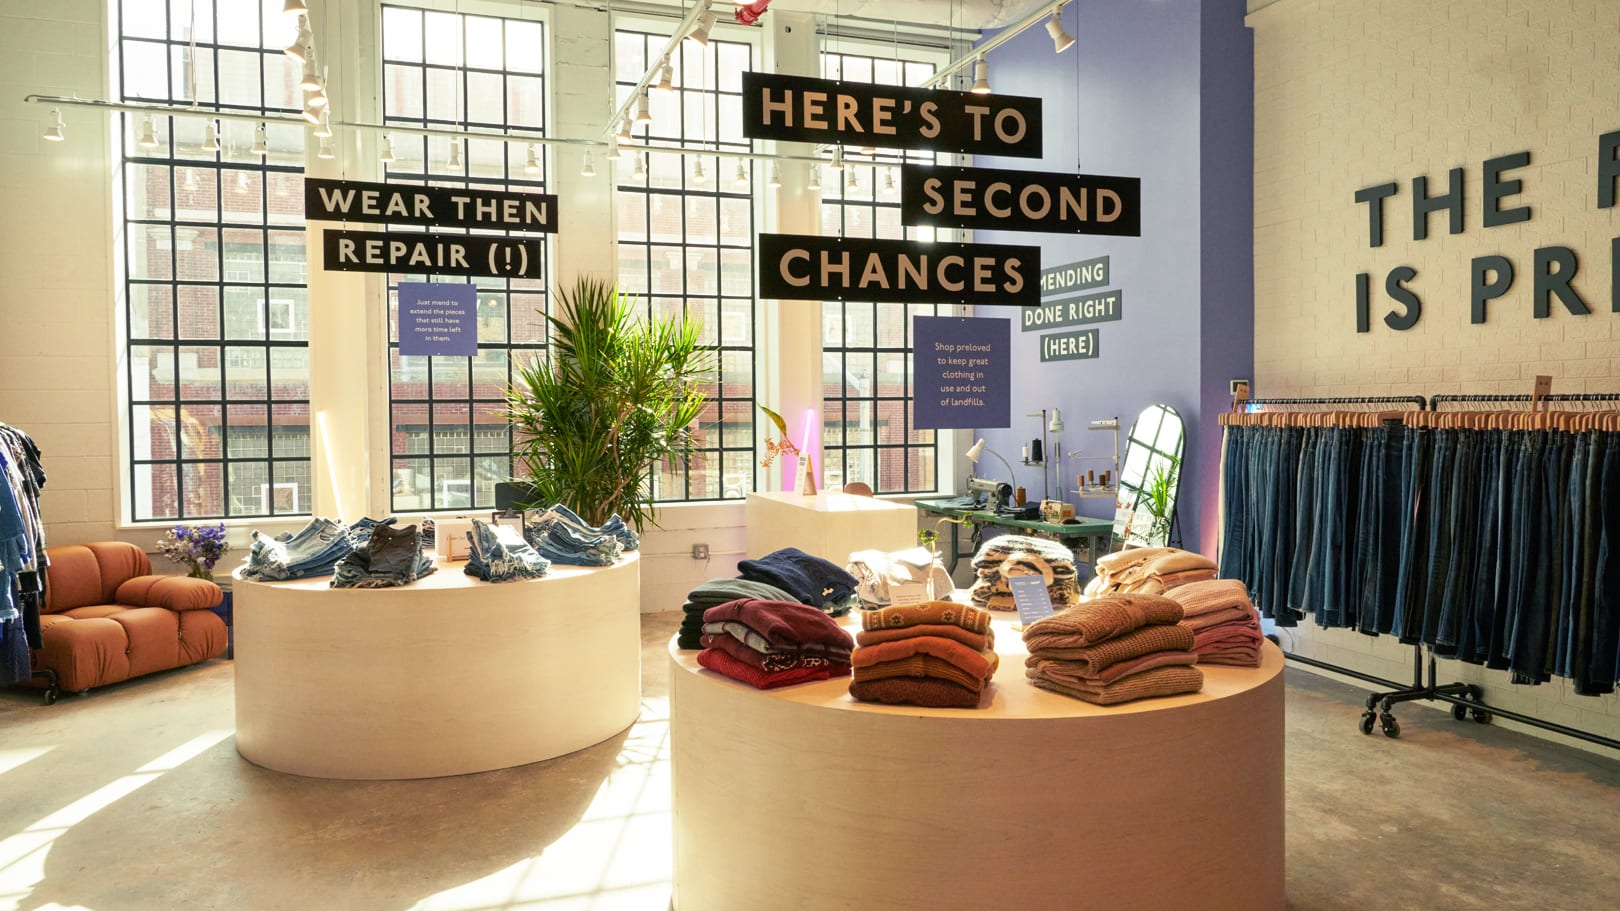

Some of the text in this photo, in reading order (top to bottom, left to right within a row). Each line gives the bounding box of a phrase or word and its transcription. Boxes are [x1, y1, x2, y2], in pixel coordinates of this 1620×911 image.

[761, 87, 1028, 145] HERE'S TO
[318, 187, 548, 225] WEAR THEN
[922, 177, 1123, 223] SECOND
[1354, 151, 1532, 249] THE
[338, 238, 528, 275] REPAIR (!)
[779, 248, 1025, 294] CHANCES
[1355, 237, 1620, 333] IS PR
[1025, 297, 1116, 326] DONE RIGHT
[935, 342, 991, 353] Shop preloved
[937, 356, 989, 368] to keep great
[1044, 332, 1093, 360] (HERE)
[942, 370, 984, 381] clothing in
[955, 385, 971, 393] and
[940, 398, 950, 406] of
